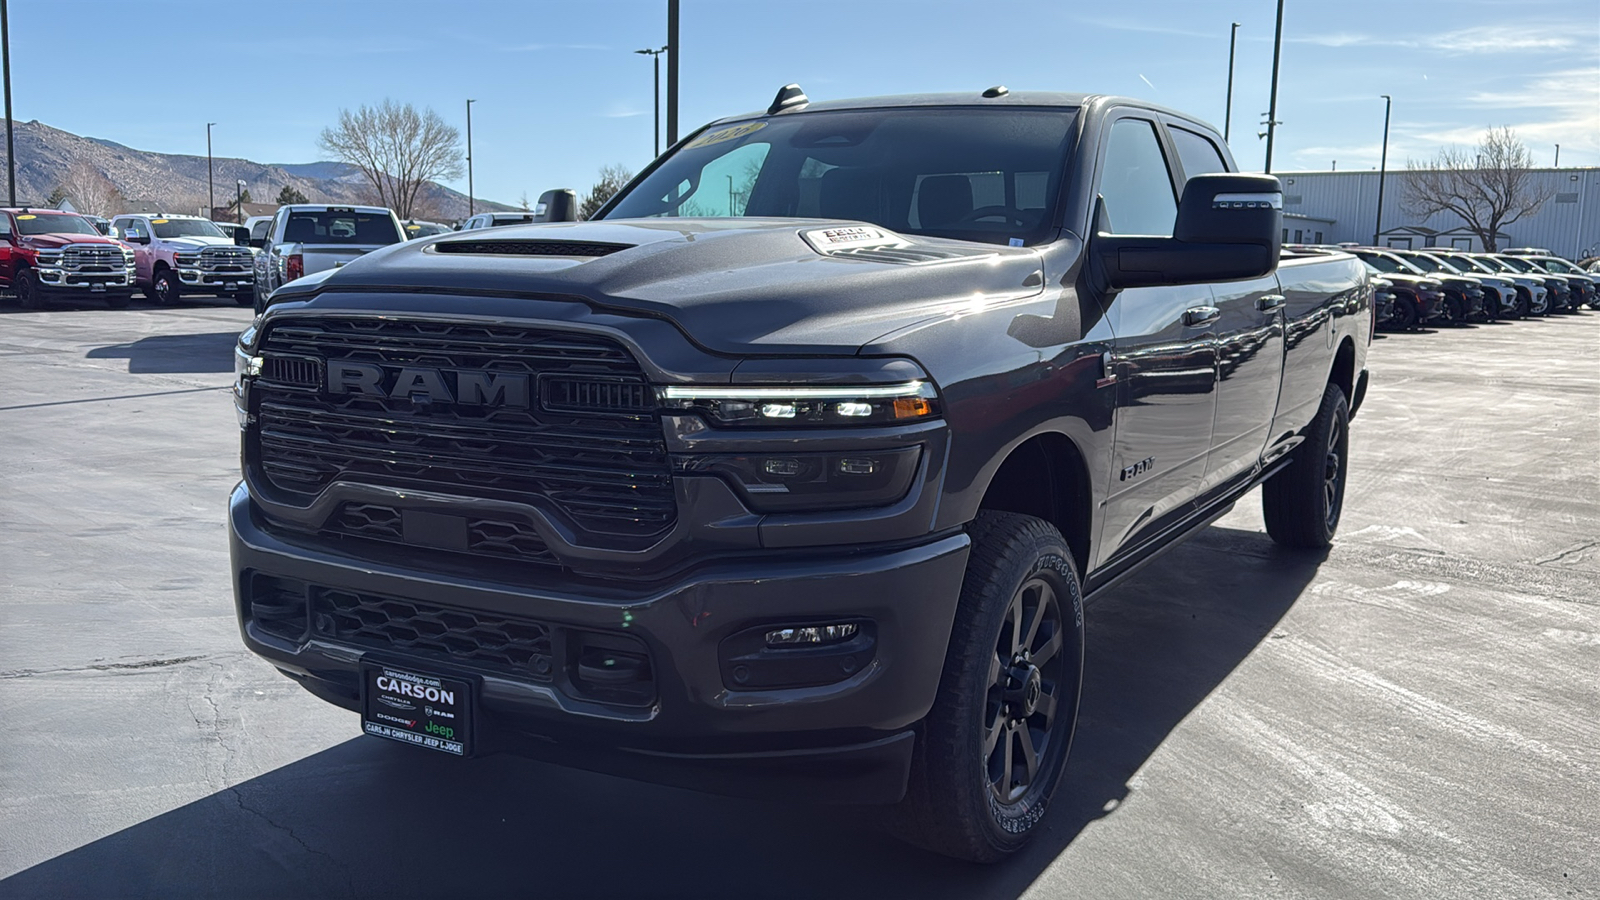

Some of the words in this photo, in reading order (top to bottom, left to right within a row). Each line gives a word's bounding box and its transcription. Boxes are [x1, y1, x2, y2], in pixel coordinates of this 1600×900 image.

[327, 359, 530, 409] RAM
[1120, 456, 1156, 481] RAM
[384, 669, 440, 687] carsondodge.com
[376, 676, 454, 705] CARSON
[381, 694, 411, 704] CHRYSLER
[377, 713, 411, 725] DODGE
[433, 710, 454, 718] RAM
[391, 729, 423, 743] CHRYSLER
[424, 738, 439, 747] JEEP
[425, 720, 454, 739] Jeep
